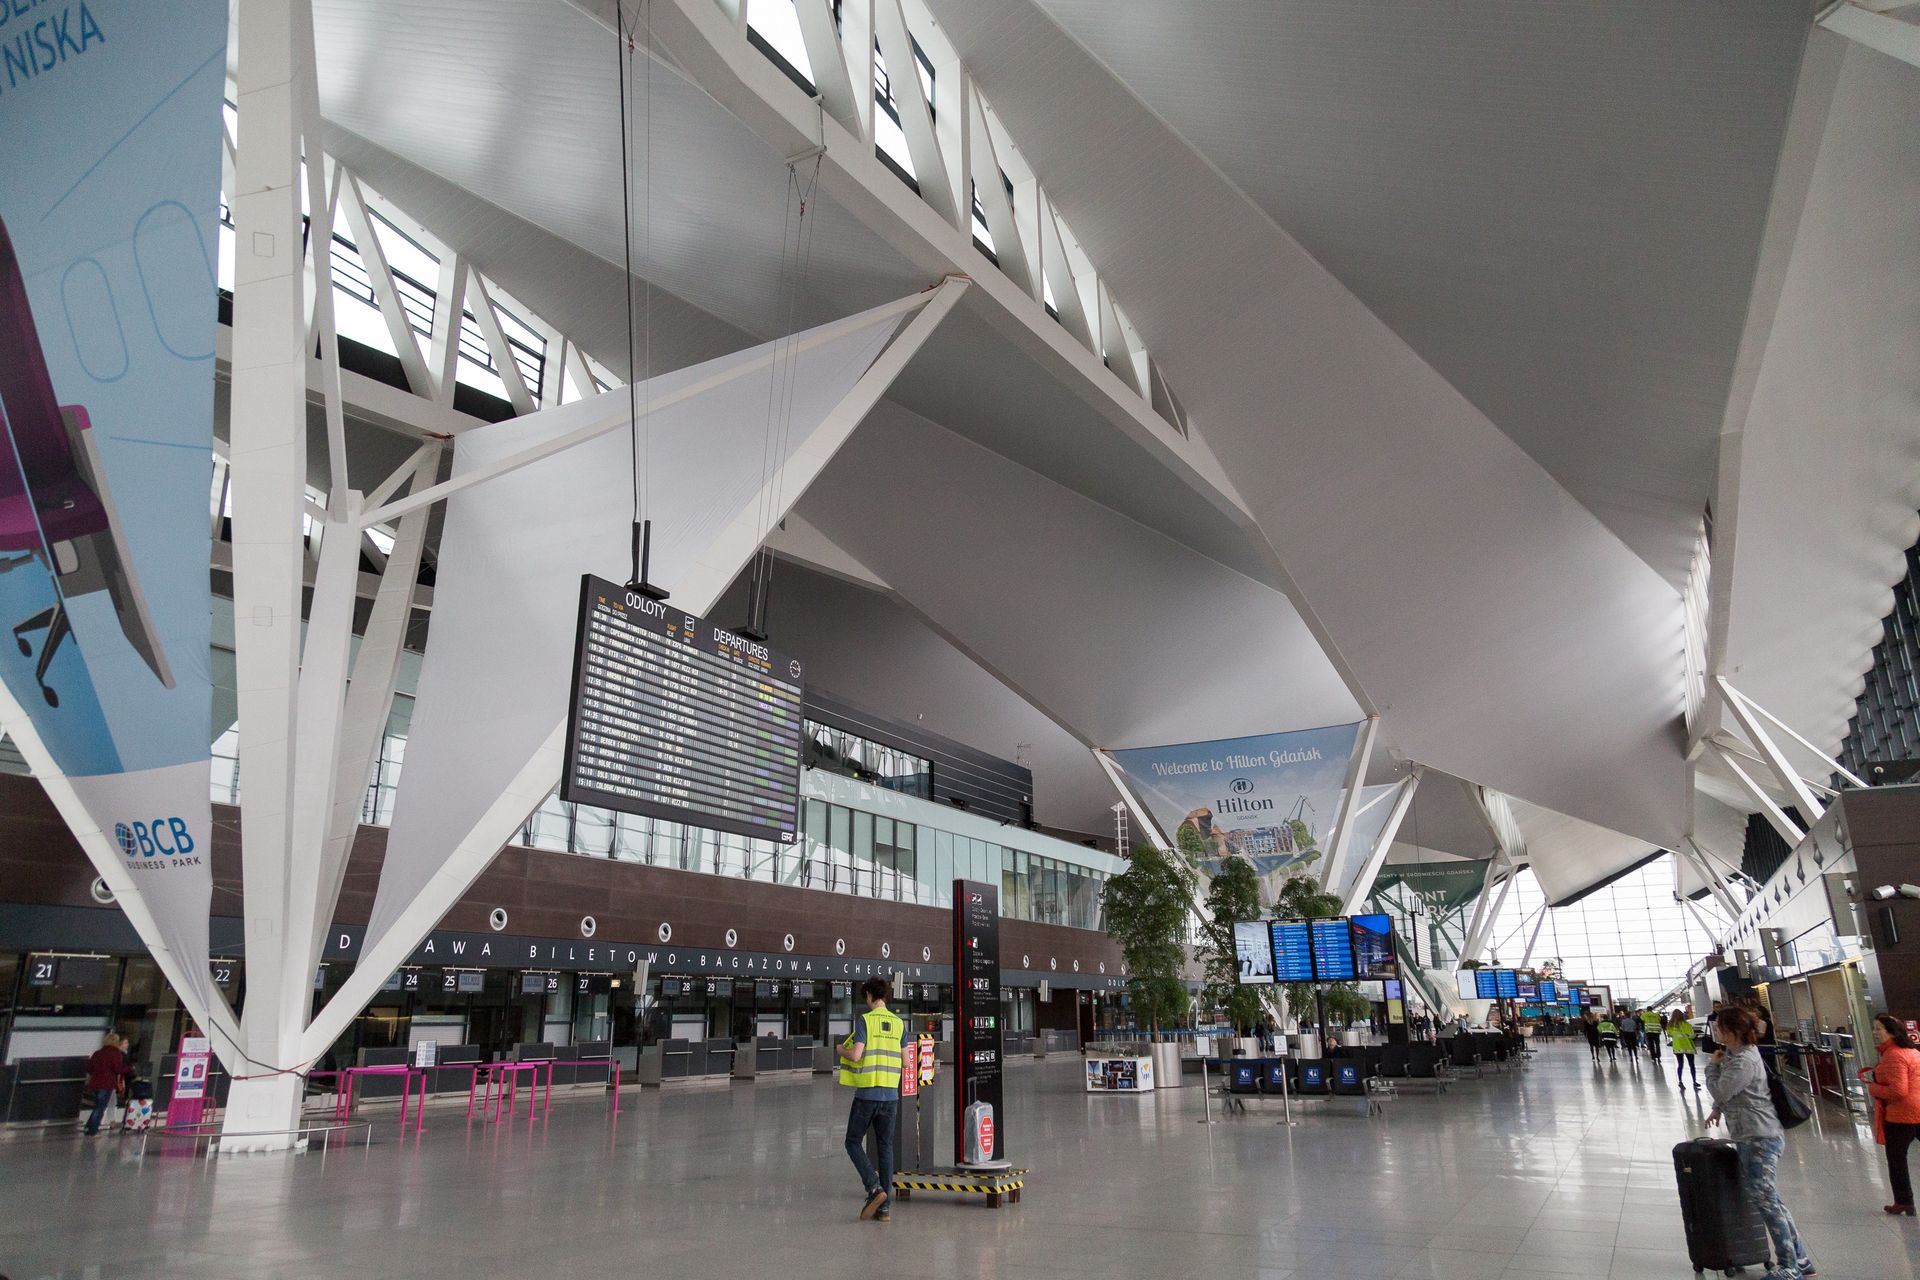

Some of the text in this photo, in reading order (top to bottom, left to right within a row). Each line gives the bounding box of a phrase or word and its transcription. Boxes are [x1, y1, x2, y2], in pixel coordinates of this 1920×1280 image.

[0, 2, 105, 94] NISKA
[626, 592, 666, 620] ODLOTY
[714, 628, 768, 661] DEPARTURES
[1152, 746, 1322, 776] Welcome to Hilton Gdańsk
[1216, 797, 1274, 814] Hilton
[132, 817, 194, 858] BCB
[126, 856, 202, 870] BUSINESS PARK
[36, 964, 52, 978] 21
[215, 969, 230, 982] 22
[406, 975, 418, 985] 24
[445, 976, 455, 986] 25
[548, 978, 557, 988] 26
[580, 980, 588, 988] 27
[682, 982, 690, 991] 28
[708, 983, 715, 991] 29
[772, 985, 778, 993] 30
[794, 986, 800, 994] 31
